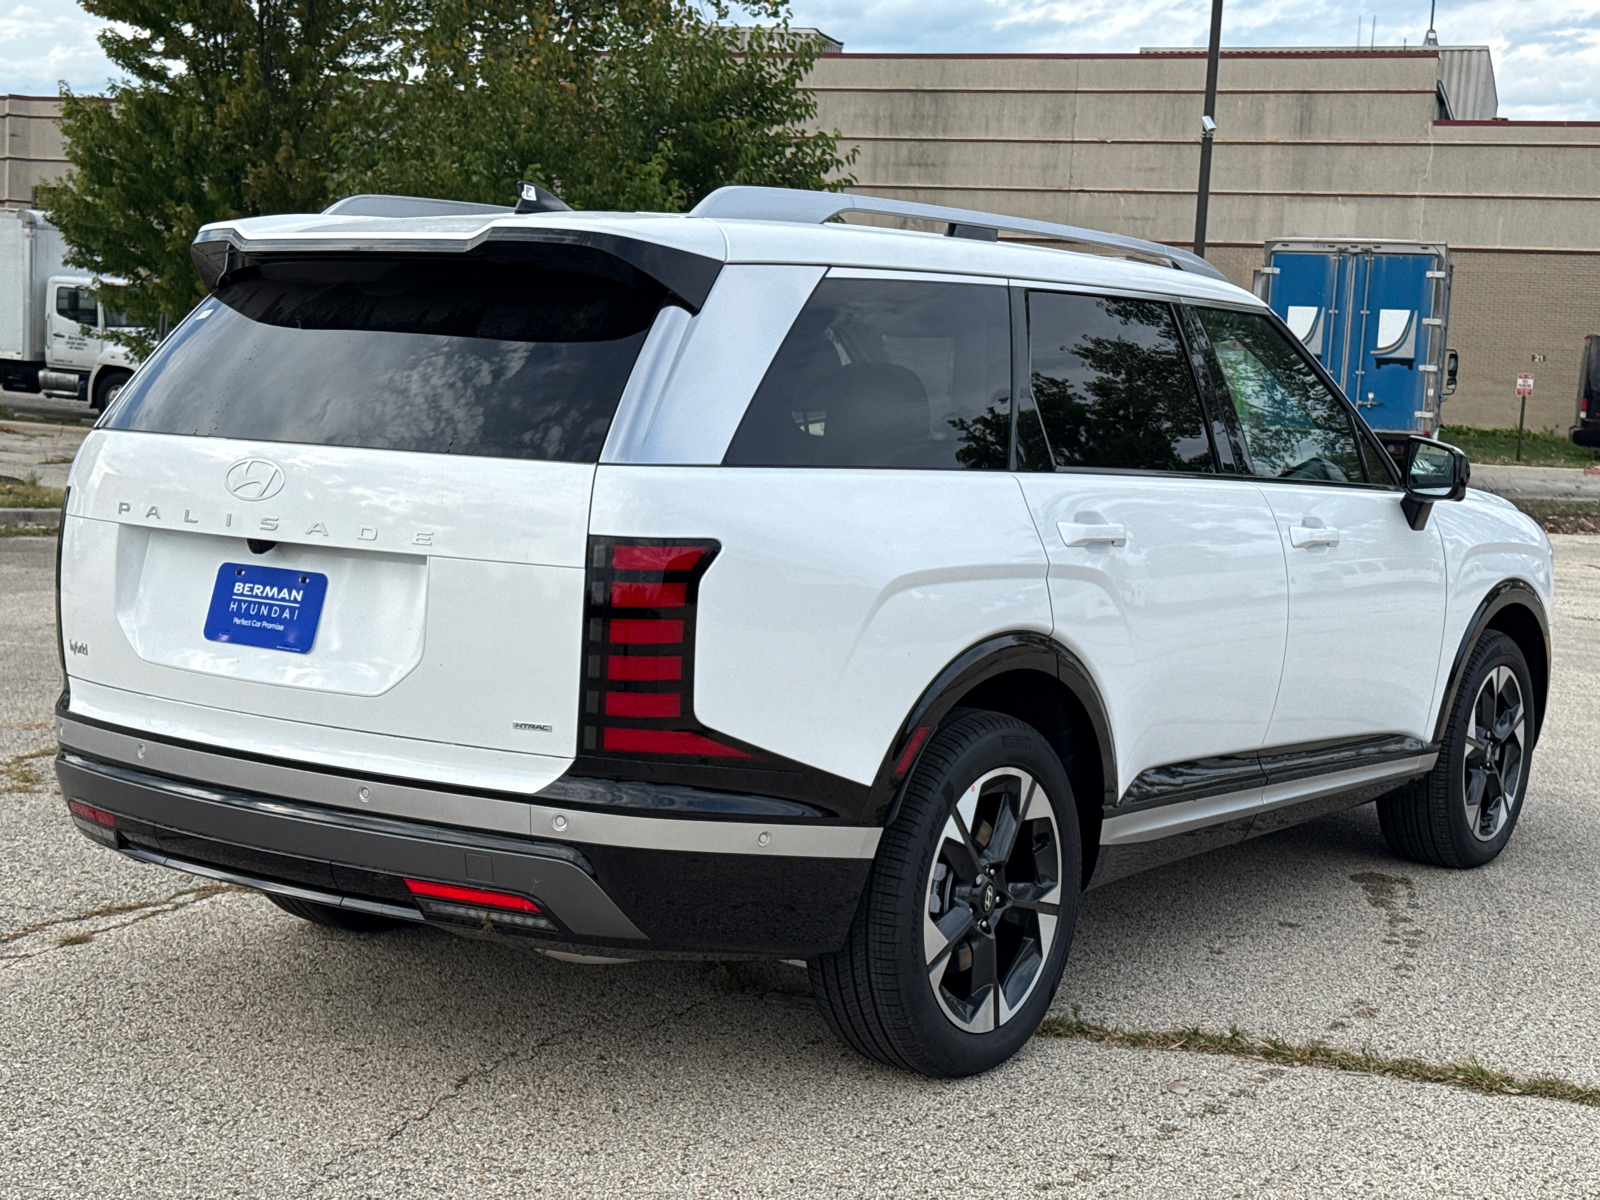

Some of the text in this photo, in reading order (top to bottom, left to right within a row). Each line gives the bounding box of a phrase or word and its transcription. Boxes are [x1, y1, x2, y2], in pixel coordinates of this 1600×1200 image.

[117, 501, 434, 547] PALISADE
[233, 582, 303, 601] BERMAN
[229, 601, 298, 620] HYUNDAI
[232, 617, 285, 631] Perfect Car Promise
[514, 722, 550, 731] HTRAC
[1001, 735, 1032, 750] PIRELLI
